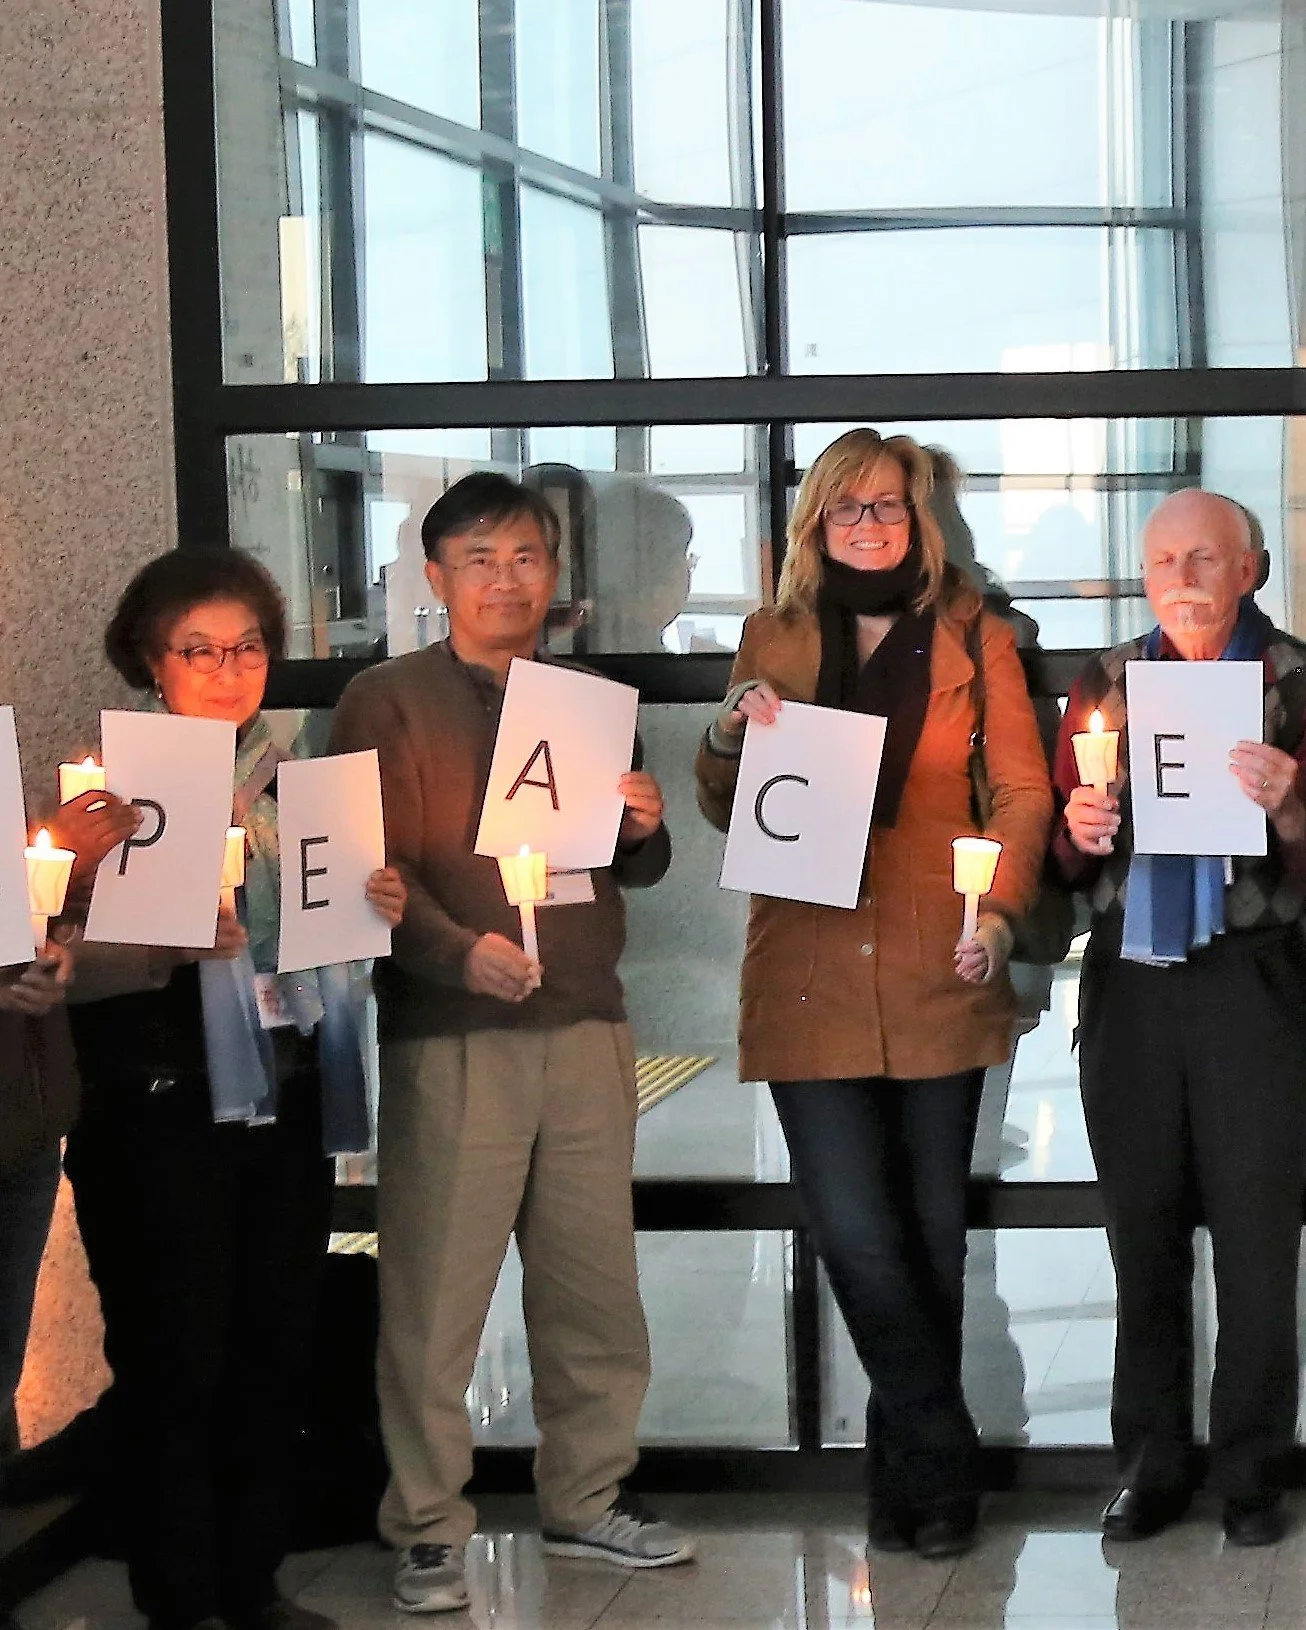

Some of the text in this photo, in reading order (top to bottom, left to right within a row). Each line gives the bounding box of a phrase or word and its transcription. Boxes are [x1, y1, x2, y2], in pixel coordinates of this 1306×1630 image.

[505, 740, 560, 811] A
[1154, 733, 1190, 799] E
[118, 798, 166, 876] P
[754, 774, 809, 842] C
[301, 836, 330, 910] E
